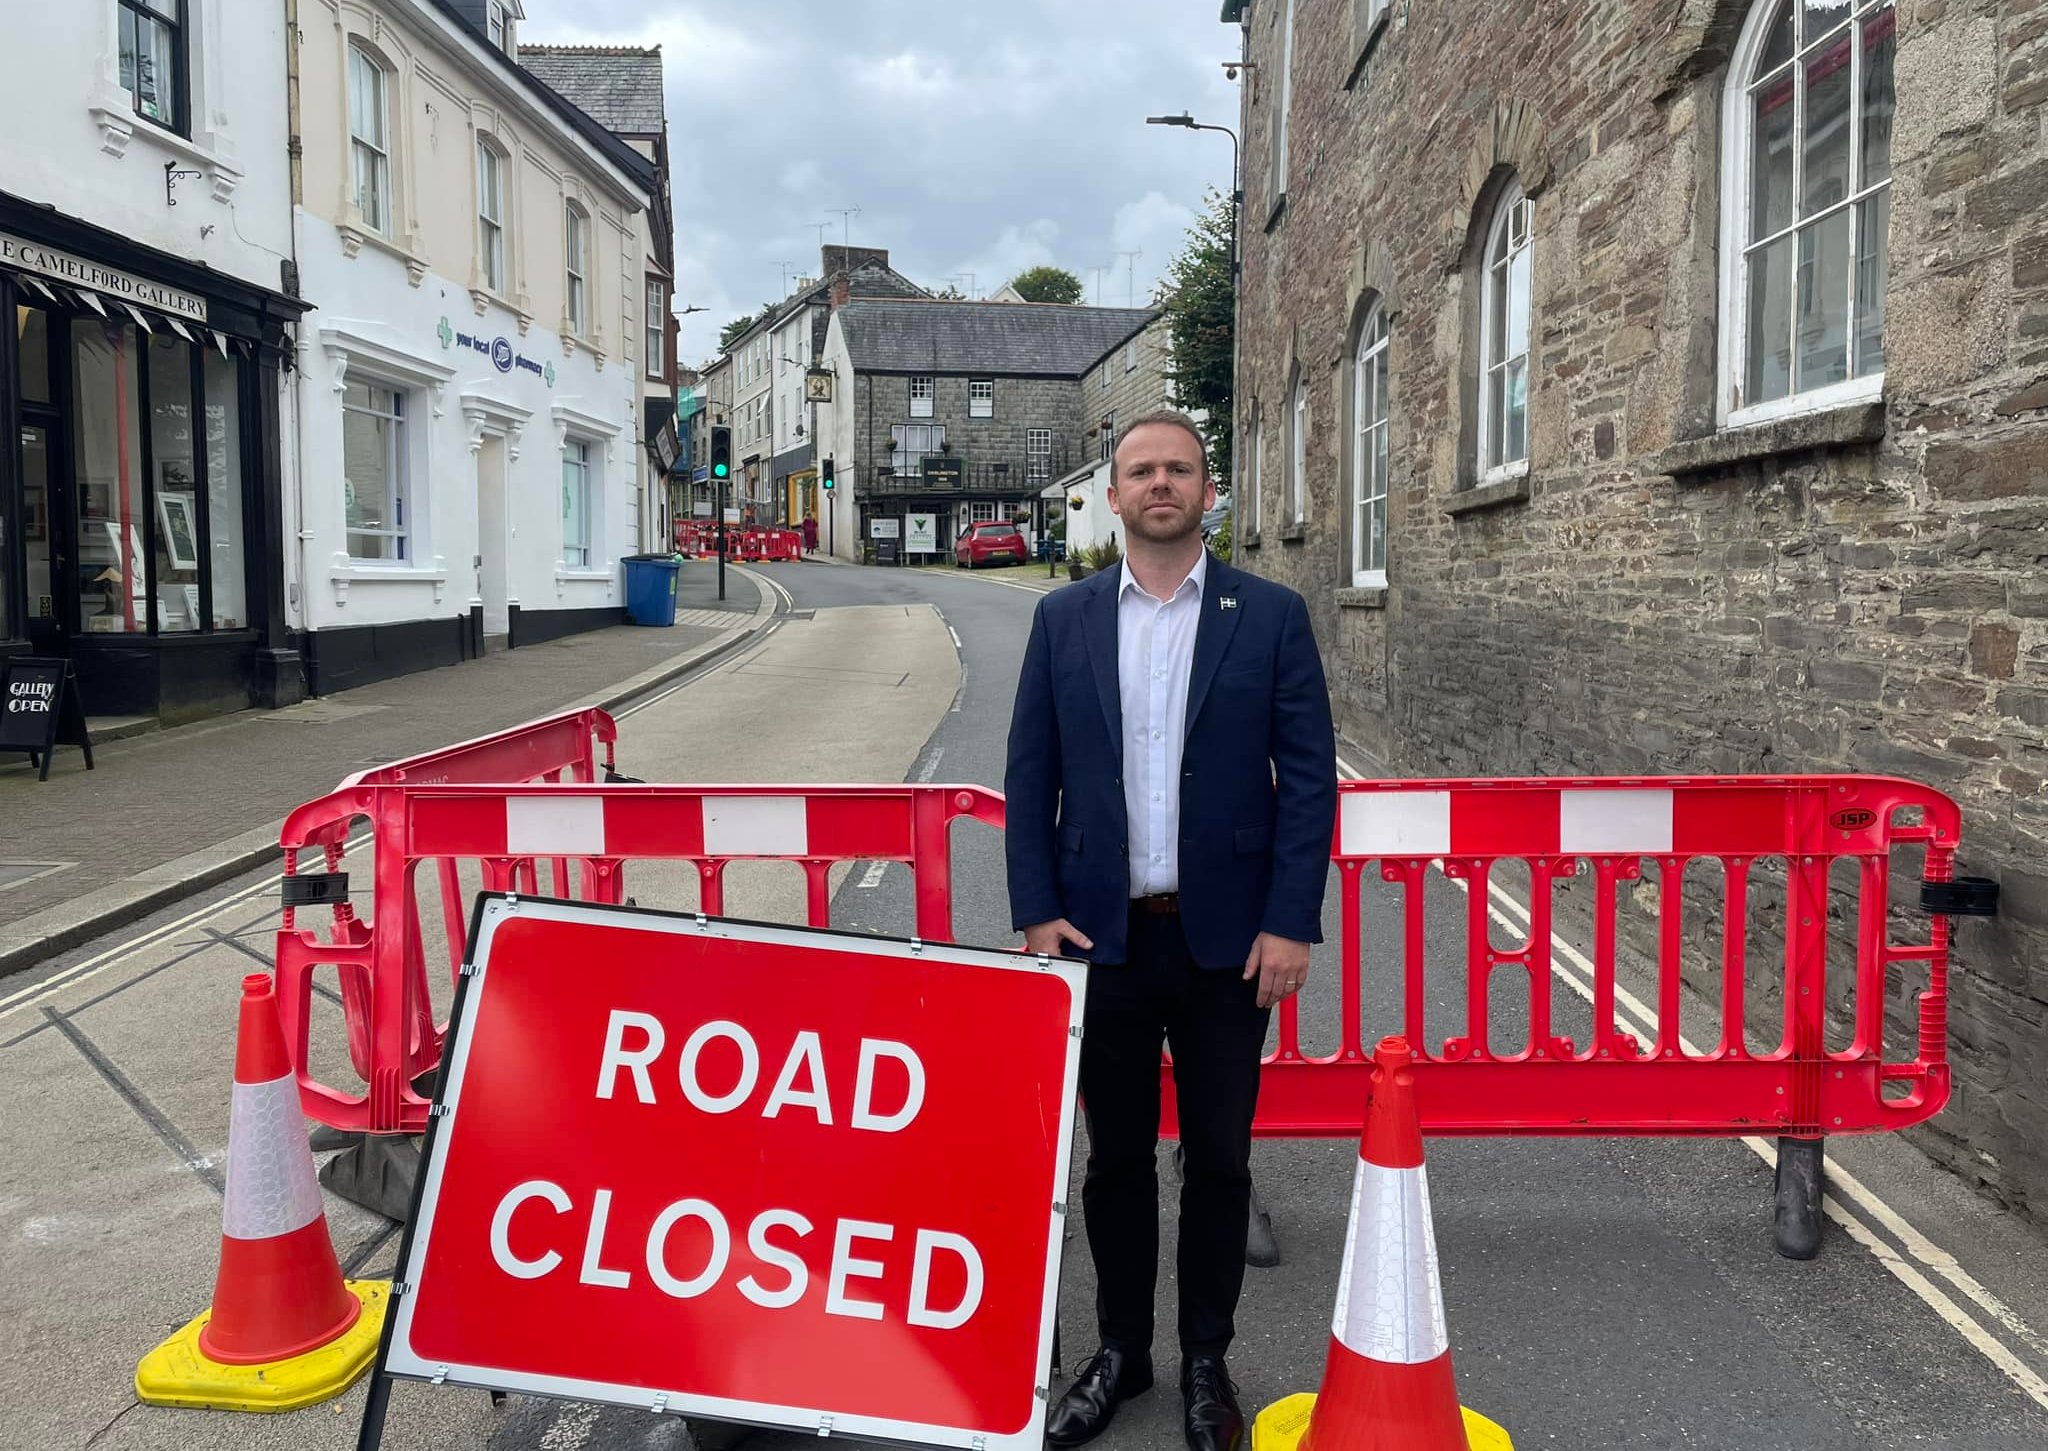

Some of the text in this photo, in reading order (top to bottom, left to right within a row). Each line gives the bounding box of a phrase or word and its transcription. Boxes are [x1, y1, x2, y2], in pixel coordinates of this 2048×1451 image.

[20, 246, 132, 294] CAMELFORD
[136, 283, 207, 317] GALLERY
[473, 335, 490, 355] local
[9, 682, 55, 700] GALLERY
[8, 699, 49, 713] OPEN
[1837, 812, 1870, 826] JSP
[595, 1009, 926, 1133] ROAD
[489, 1180, 985, 1330] CLOSED
